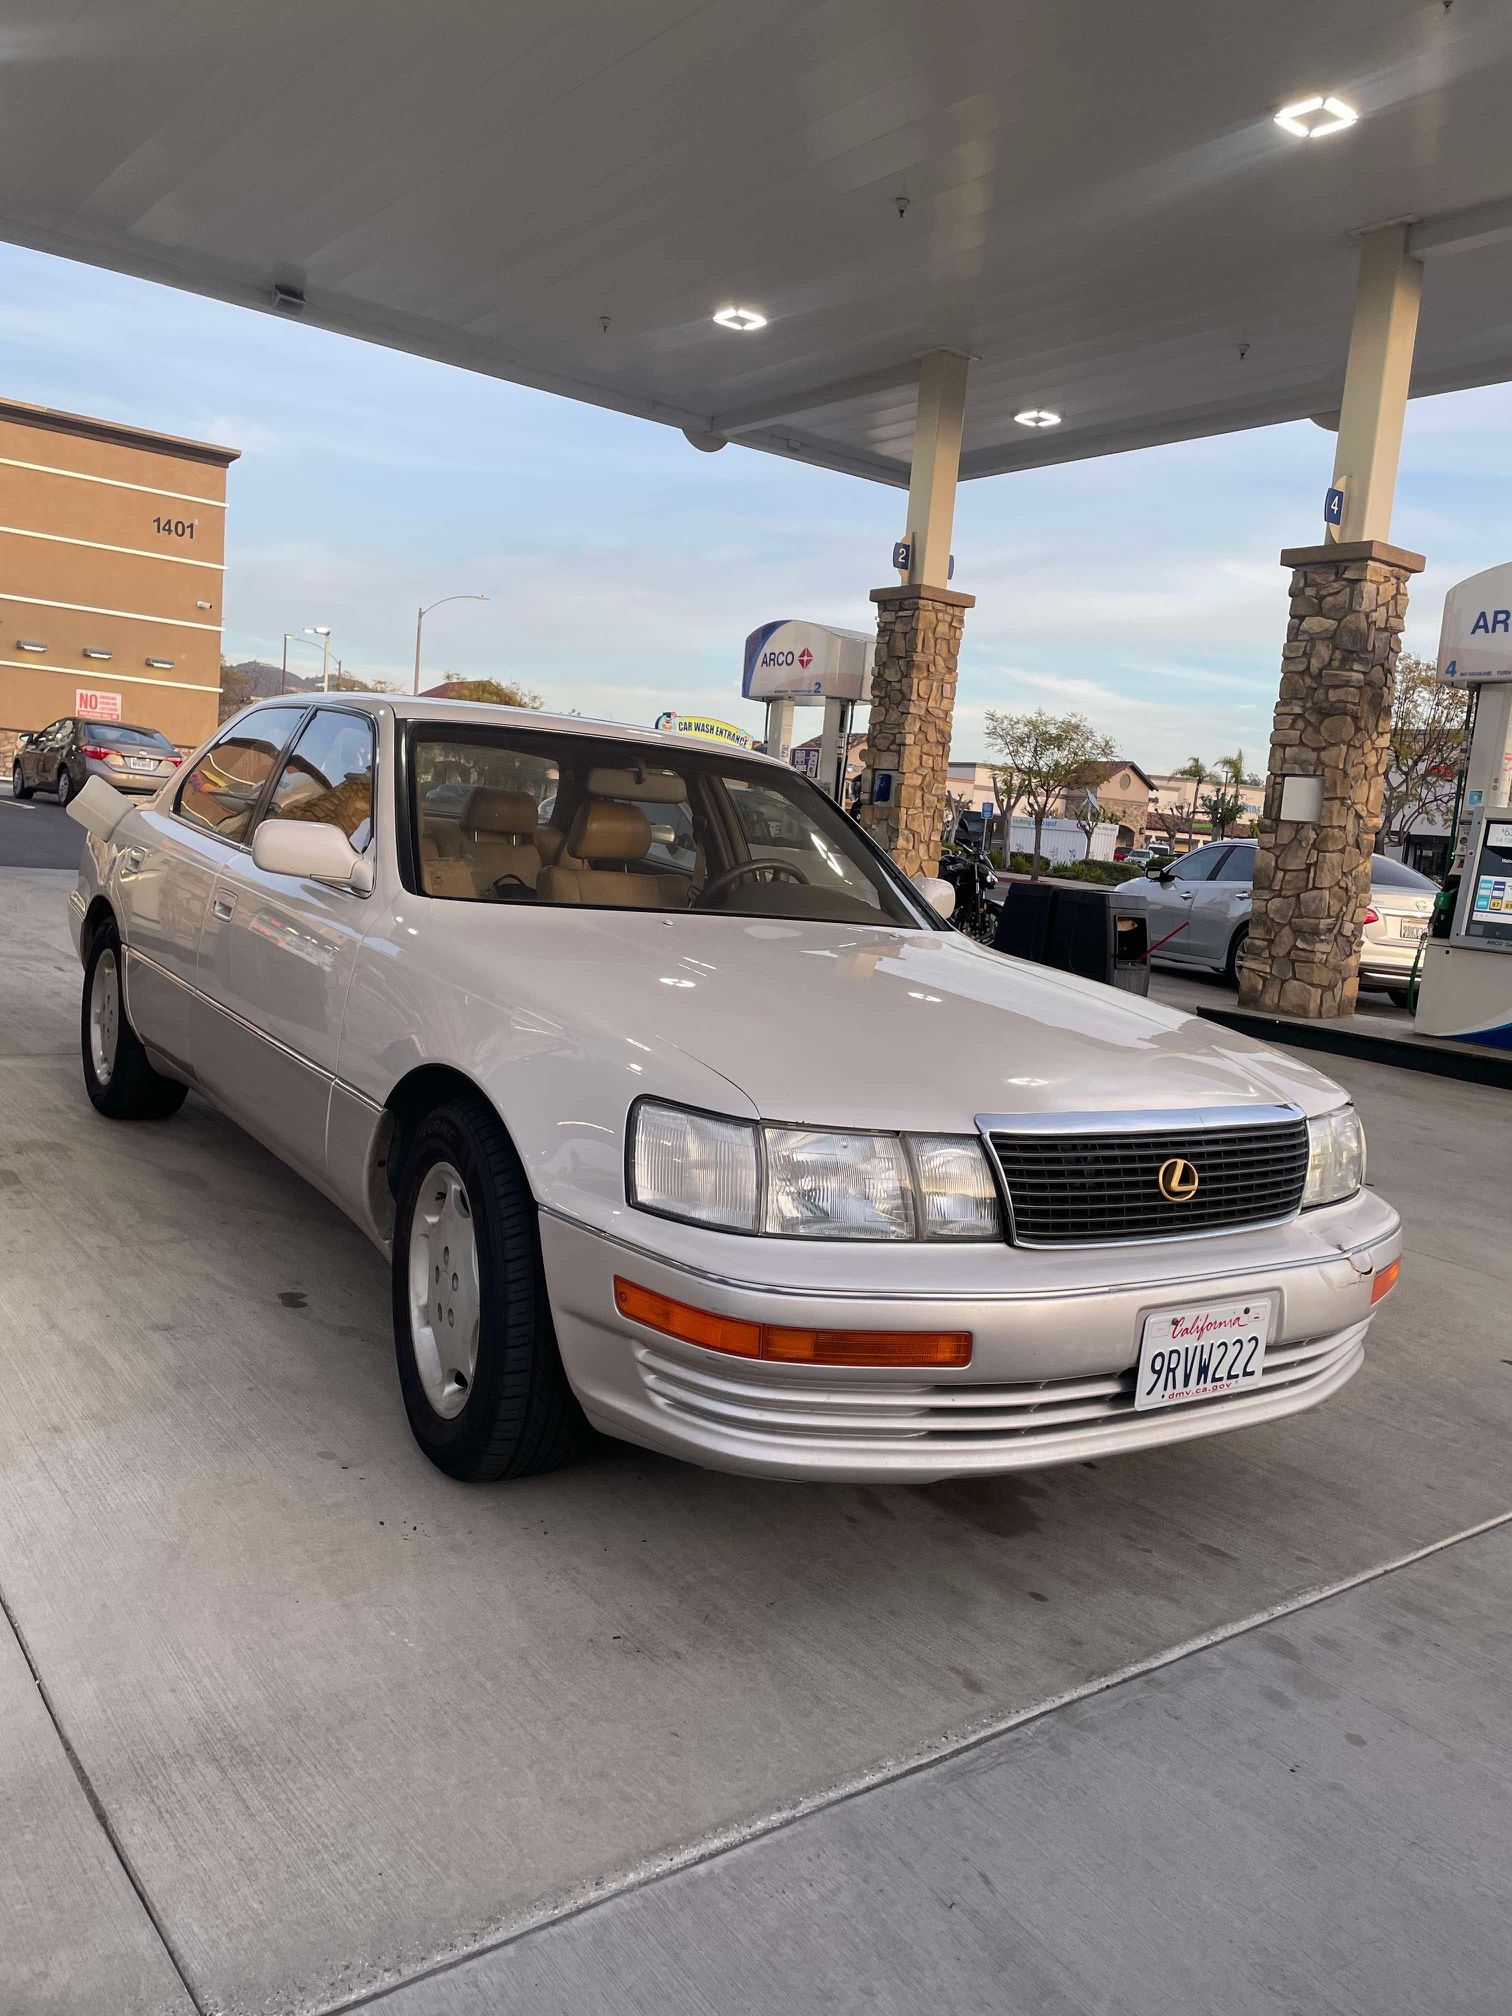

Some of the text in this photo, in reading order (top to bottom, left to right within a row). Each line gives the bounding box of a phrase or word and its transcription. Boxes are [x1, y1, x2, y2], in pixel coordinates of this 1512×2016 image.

[1331, 496, 1339, 514] 4
[153, 517, 194, 539] 1401
[898, 548, 906, 563] 2
[1471, 610, 1511, 635] AR
[761, 651, 795, 667] ARCO
[1445, 660, 1457, 677] 4
[813, 682, 822, 694] 2
[79, 693, 98, 710] NO
[678, 721, 749, 748] CAR WASH ENTRANCE
[1172, 1313, 1247, 1341] California
[1146, 1336, 1259, 1396] 9RVW222
[1168, 1382, 1232, 1400] dmv.ca.gov
